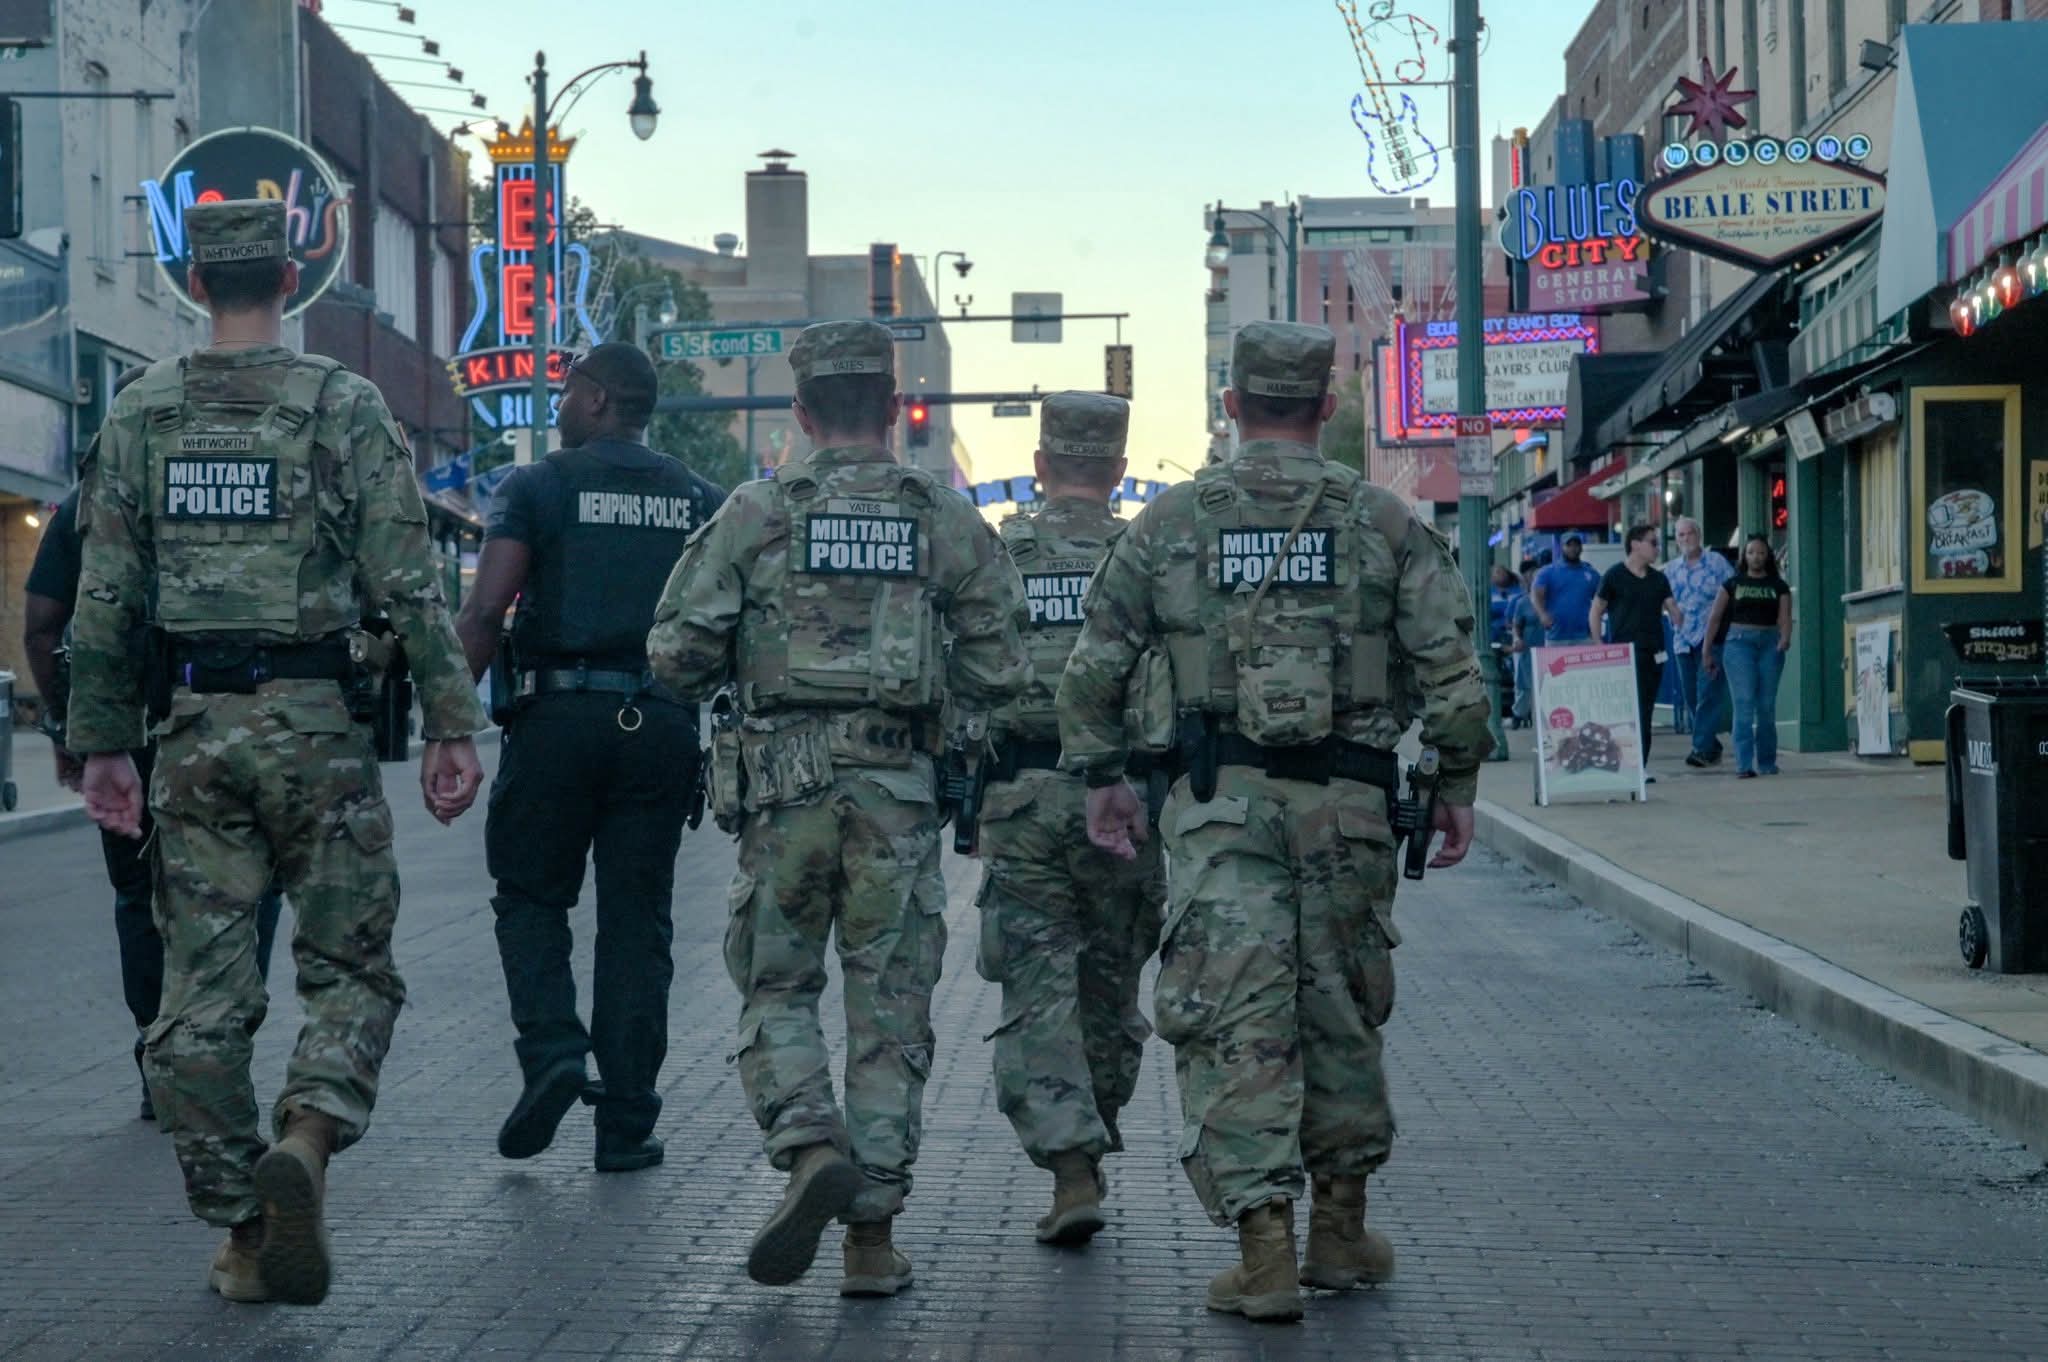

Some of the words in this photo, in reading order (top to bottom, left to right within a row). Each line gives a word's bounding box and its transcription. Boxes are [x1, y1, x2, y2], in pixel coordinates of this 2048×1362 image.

[1665, 135, 1872, 168] WELCOME
[1664, 193, 1754, 219] BEALE
[1766, 186, 1874, 214] STREET
[1519, 178, 1637, 260] BLUES
[205, 244, 269, 259] WHITWORTH
[1540, 236, 1641, 270] CITY
[1537, 267, 1638, 289] GENERAL
[1555, 286, 1623, 305] STORE
[1507, 315, 1547, 331] BAND
[1550, 313, 1580, 327] BOX
[689, 334, 749, 355] Second
[1541, 346, 1570, 359] MOUTH
[832, 360, 865, 371] YATES
[1538, 360, 1570, 374] CLUB
[1493, 392, 1514, 404] THAT
[1462, 420, 1485, 433] NO
[183, 438, 248, 449] WHITWORTH
[168, 463, 271, 485] MILITARY
[168, 487, 271, 515] POLICE
[579, 492, 642, 525] MEMPHIS
[644, 495, 690, 529] POLICE
[849, 502, 882, 514] YATES
[811, 520, 912, 543] MILITARY
[811, 542, 912, 571] POLICE
